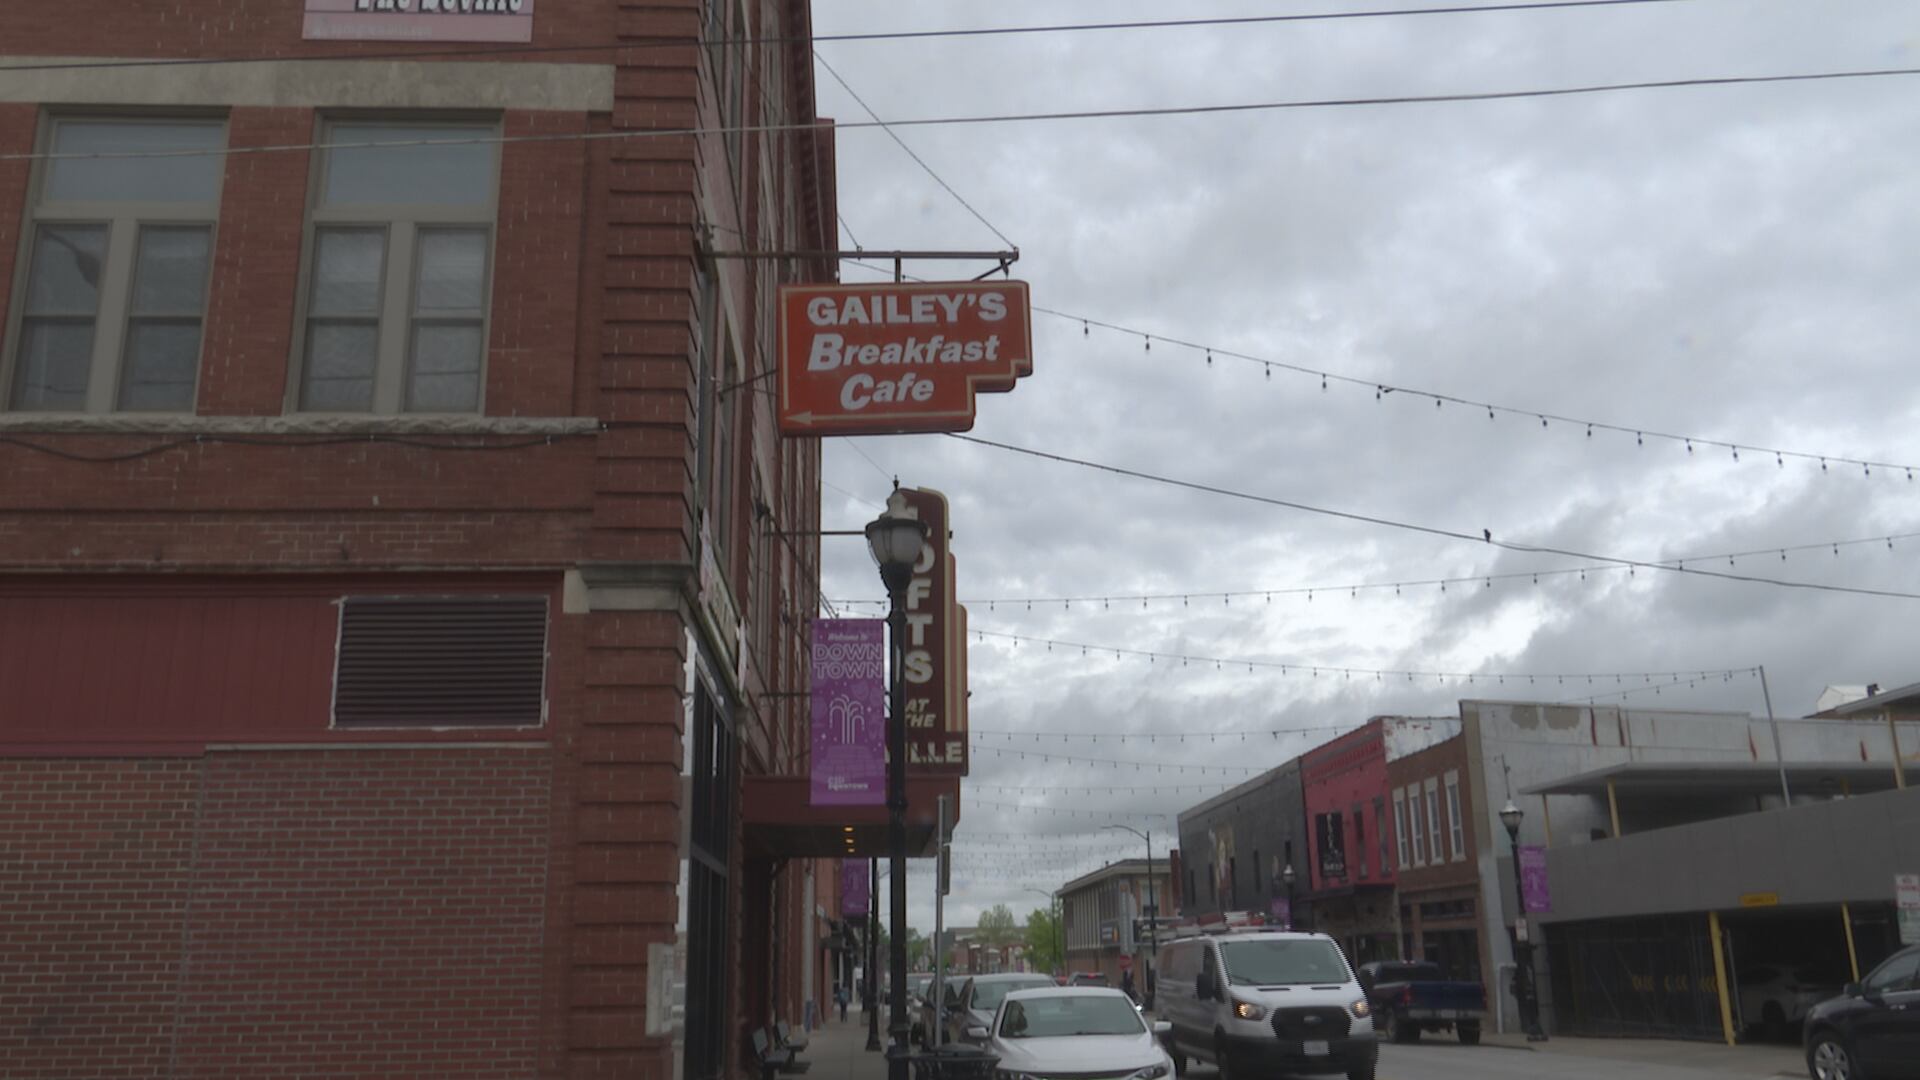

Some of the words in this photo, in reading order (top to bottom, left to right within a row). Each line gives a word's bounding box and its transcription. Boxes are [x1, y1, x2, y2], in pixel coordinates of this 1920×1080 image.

[807, 292, 1008, 326] GAILEY'S
[807, 333, 1000, 372] Breakfast
[840, 373, 935, 411] Cafe
[812, 643, 883, 660] DOWN
[812, 661, 883, 680] TOWN
[904, 698, 930, 712] AT
